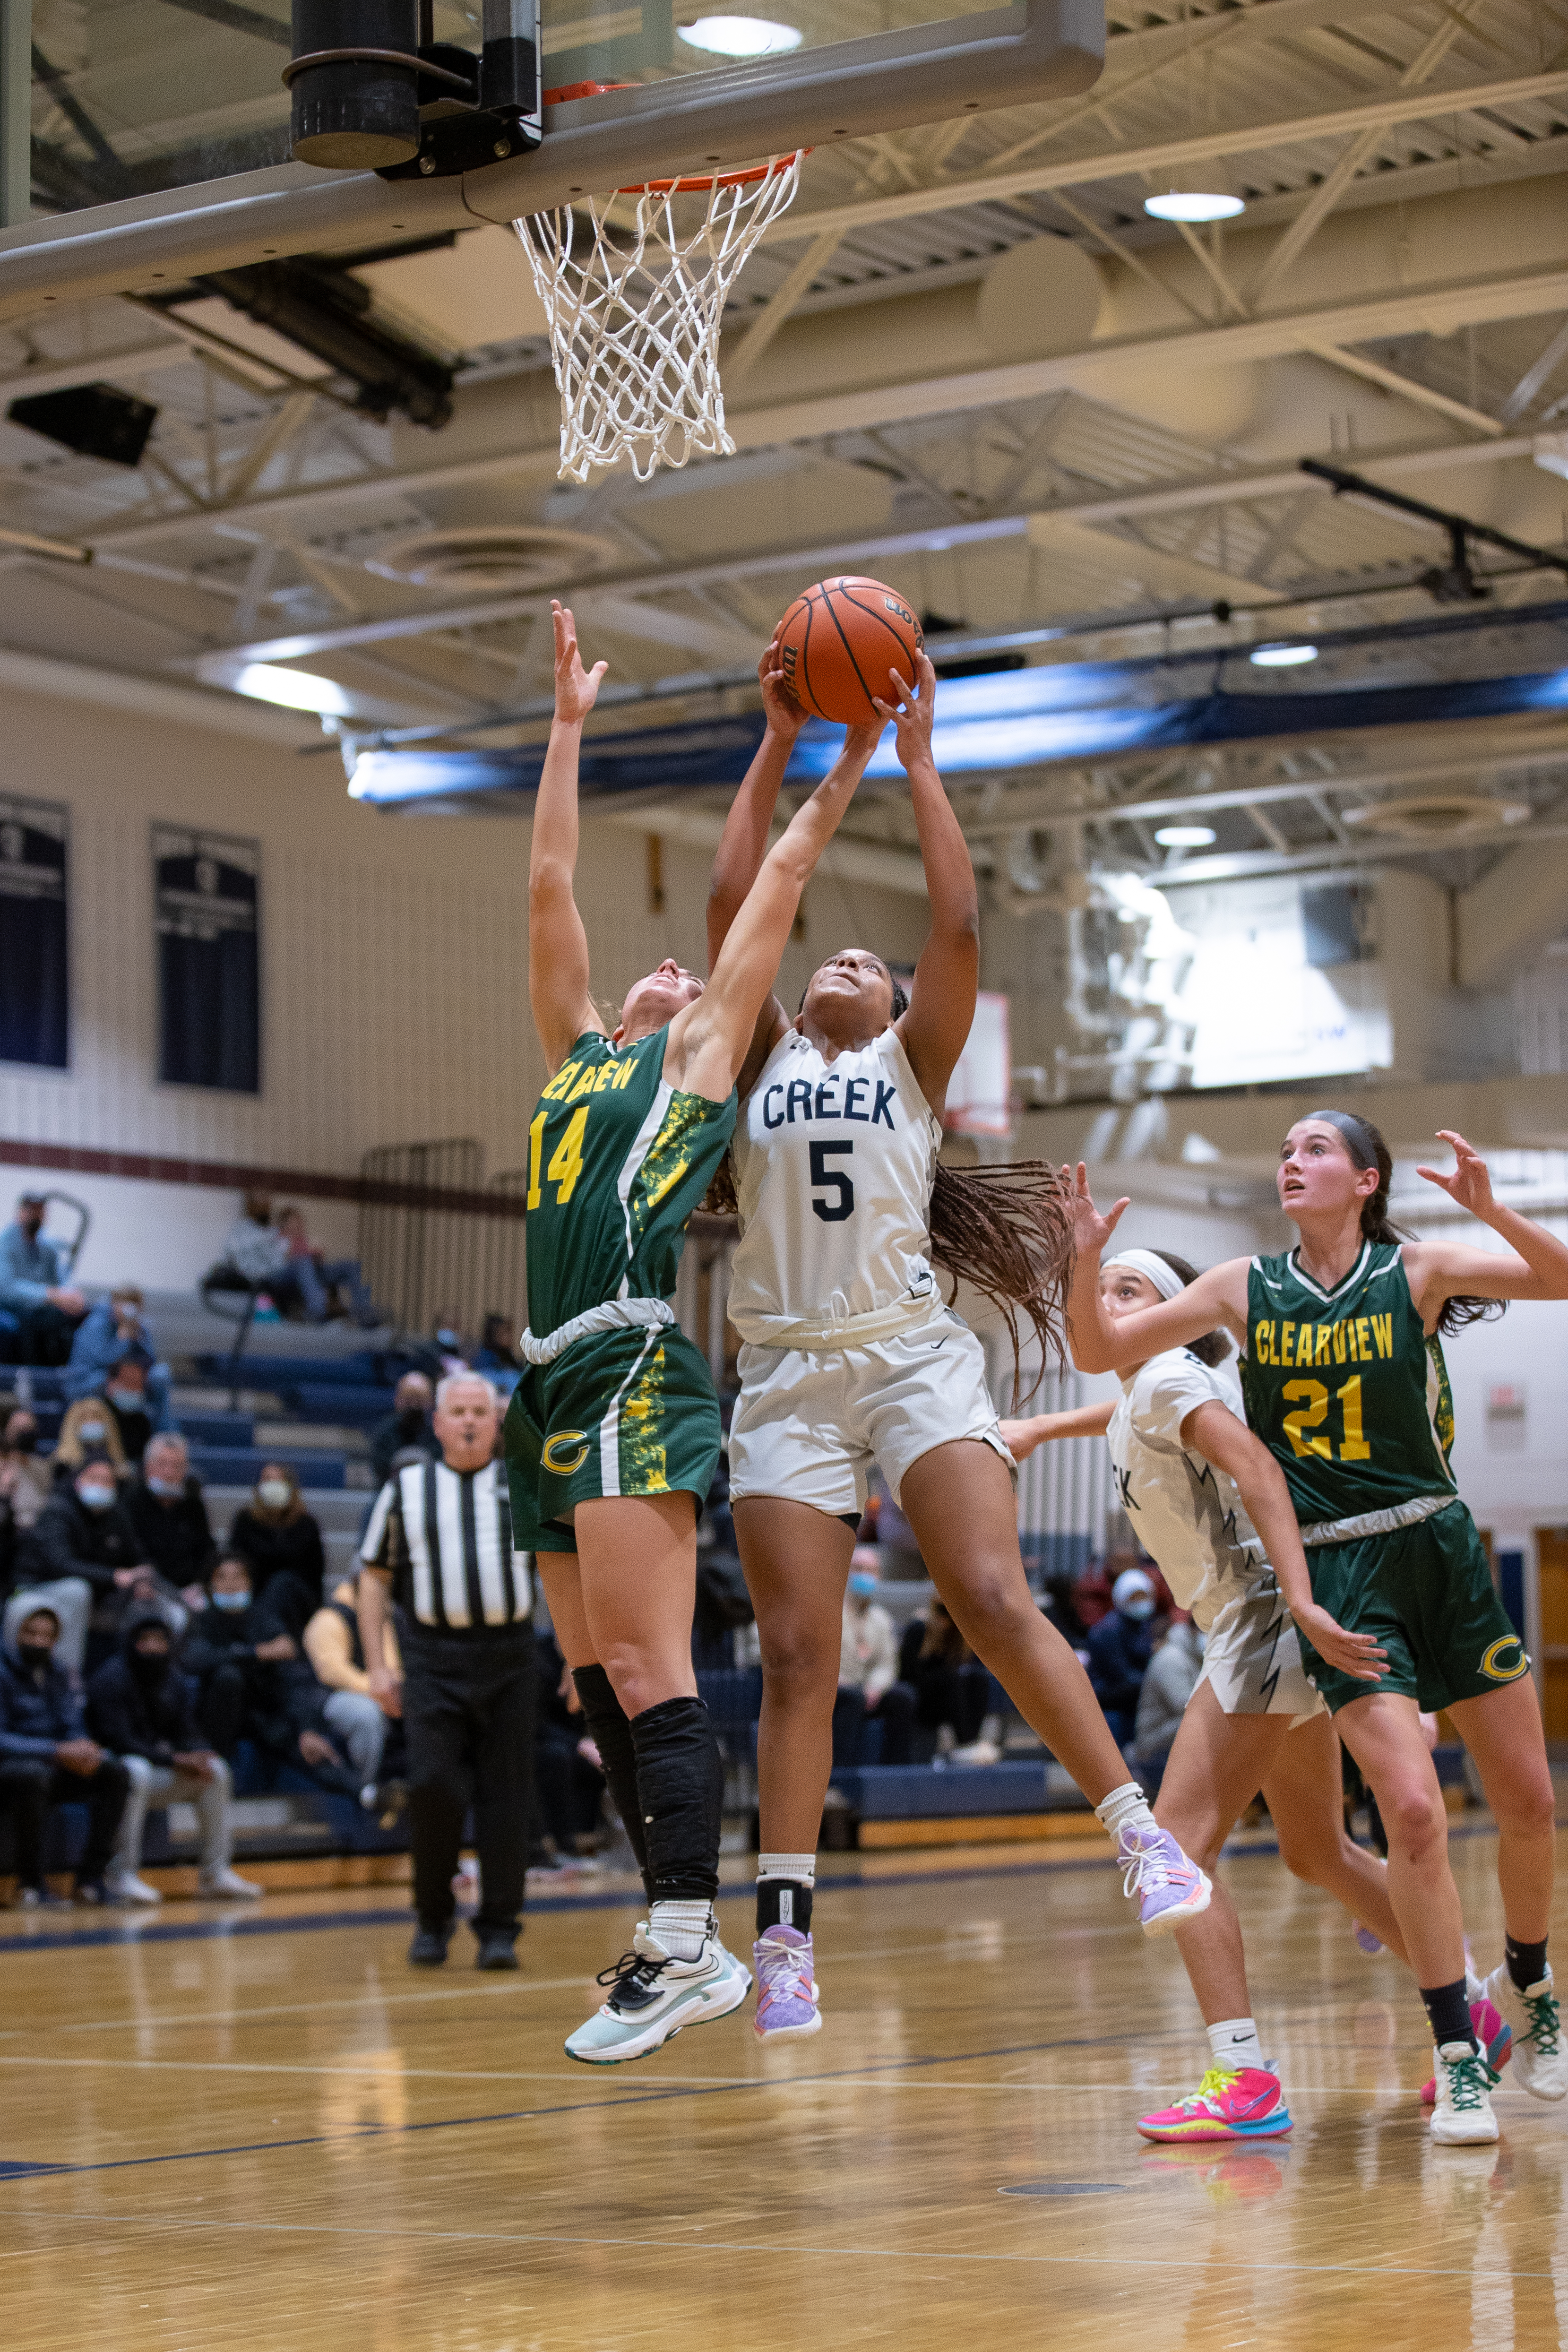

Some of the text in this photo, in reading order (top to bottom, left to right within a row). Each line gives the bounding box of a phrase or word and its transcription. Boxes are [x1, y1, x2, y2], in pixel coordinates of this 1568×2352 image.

[763, 1075, 896, 1130] CREEK
[527, 1105, 590, 1211] 14
[809, 1140, 854, 1222] 5
[1255, 1313, 1393, 1367] CLEARVIEW
[1282, 1374, 1371, 1461] 21
